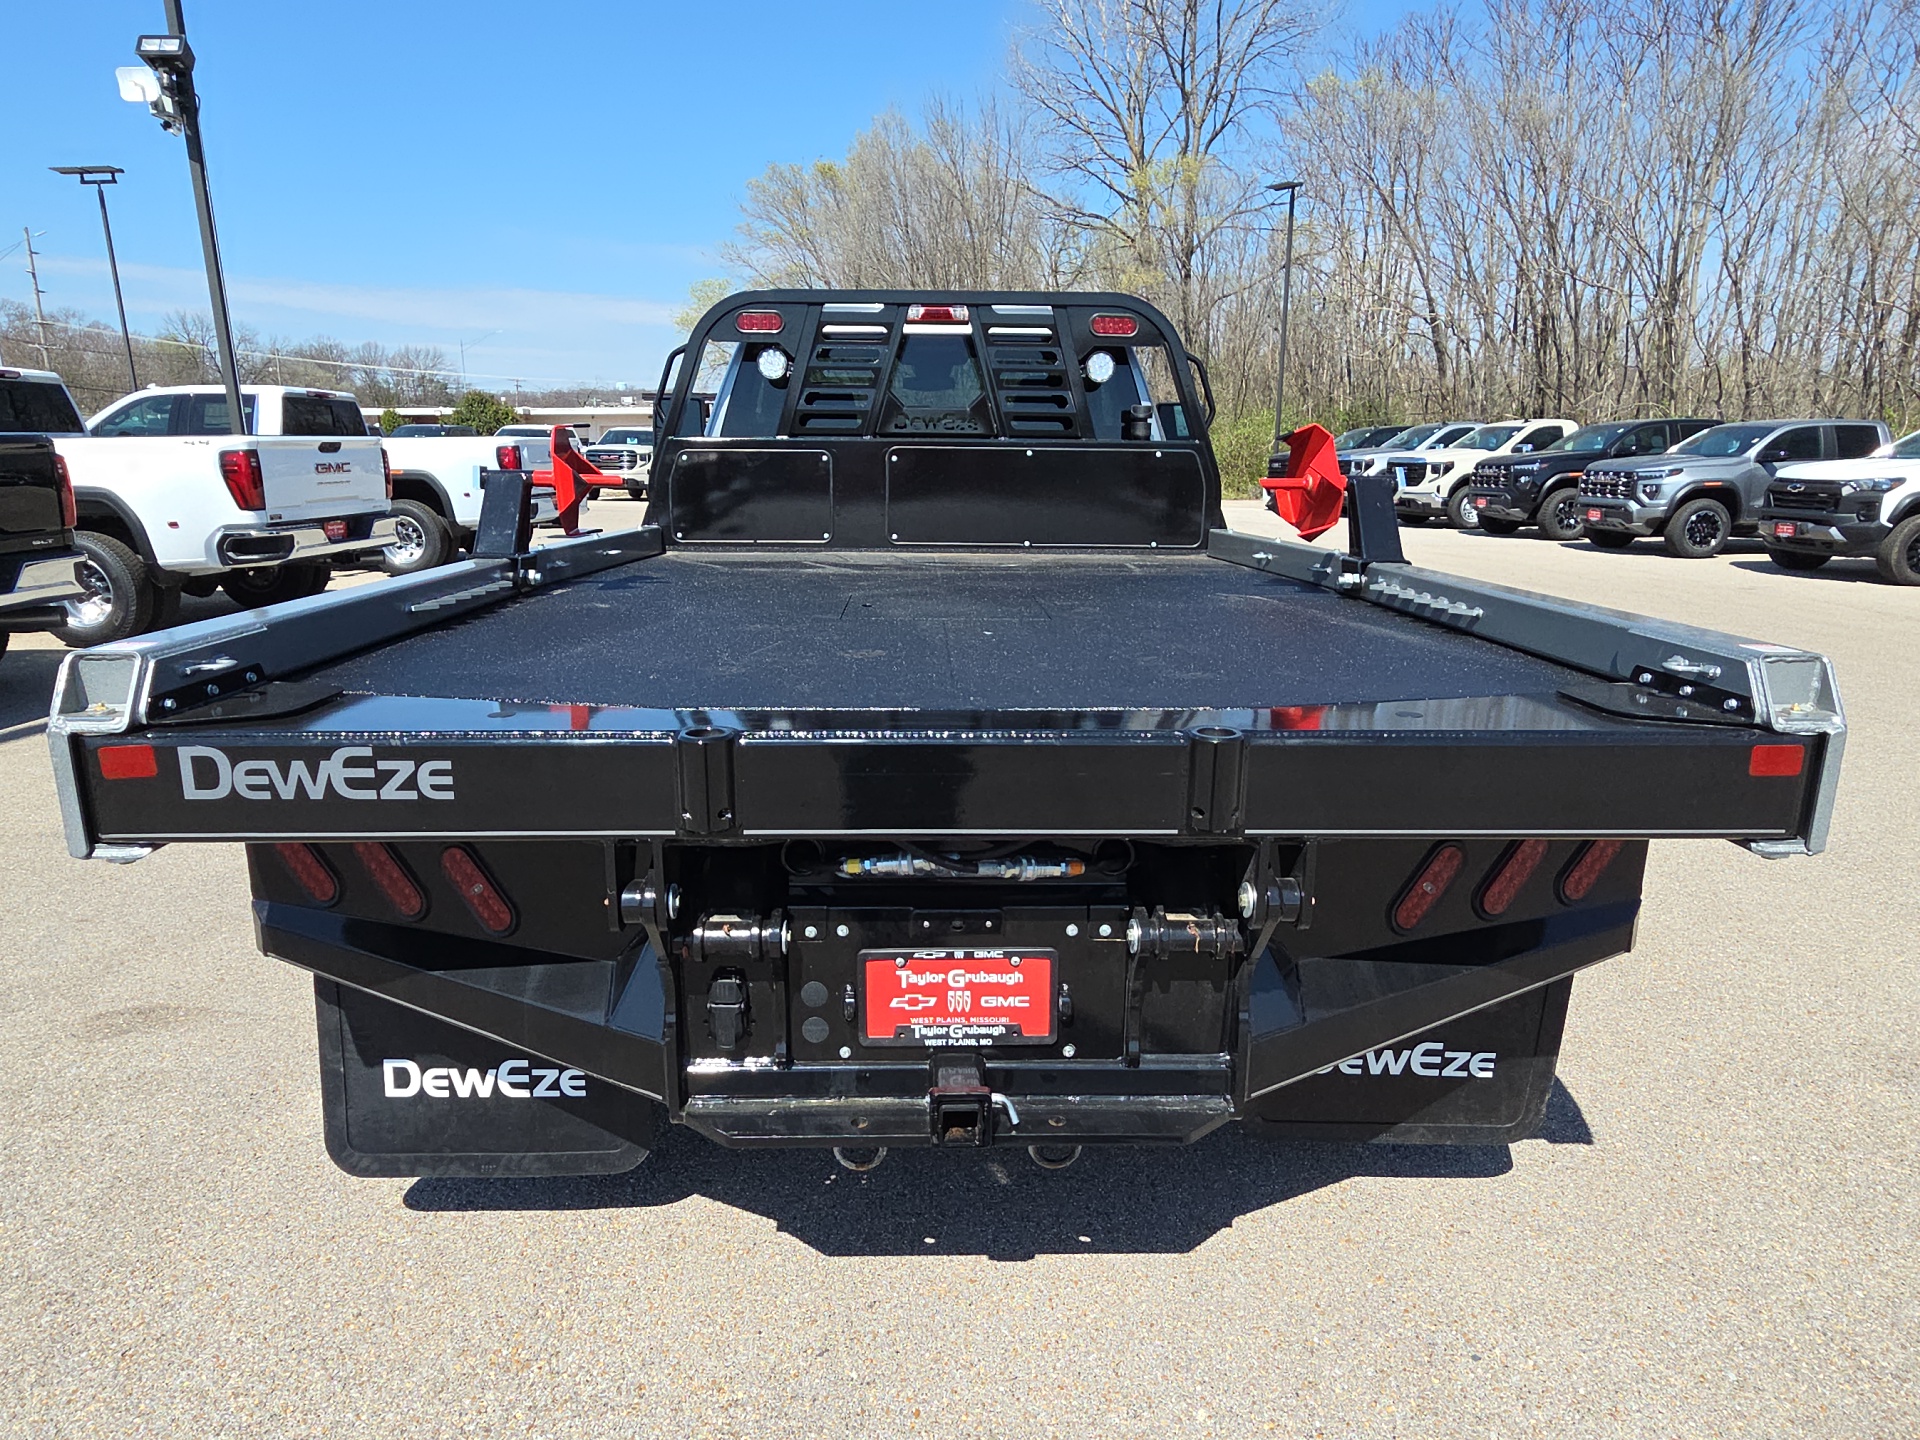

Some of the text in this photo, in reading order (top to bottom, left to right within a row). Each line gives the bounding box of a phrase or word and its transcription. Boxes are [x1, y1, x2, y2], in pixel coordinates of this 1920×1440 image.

[315, 462, 351, 474] GMC
[973, 950, 1004, 959] GMC
[895, 969, 1024, 989] Taylor Grubaugh
[980, 996, 1030, 1008] GMC
[936, 1017, 969, 1025] PLAINS,
[910, 1024, 1006, 1039] Taylor Grubaugh
[948, 1039, 979, 1047] PLAINS,
[980, 1038, 993, 1046] MO
